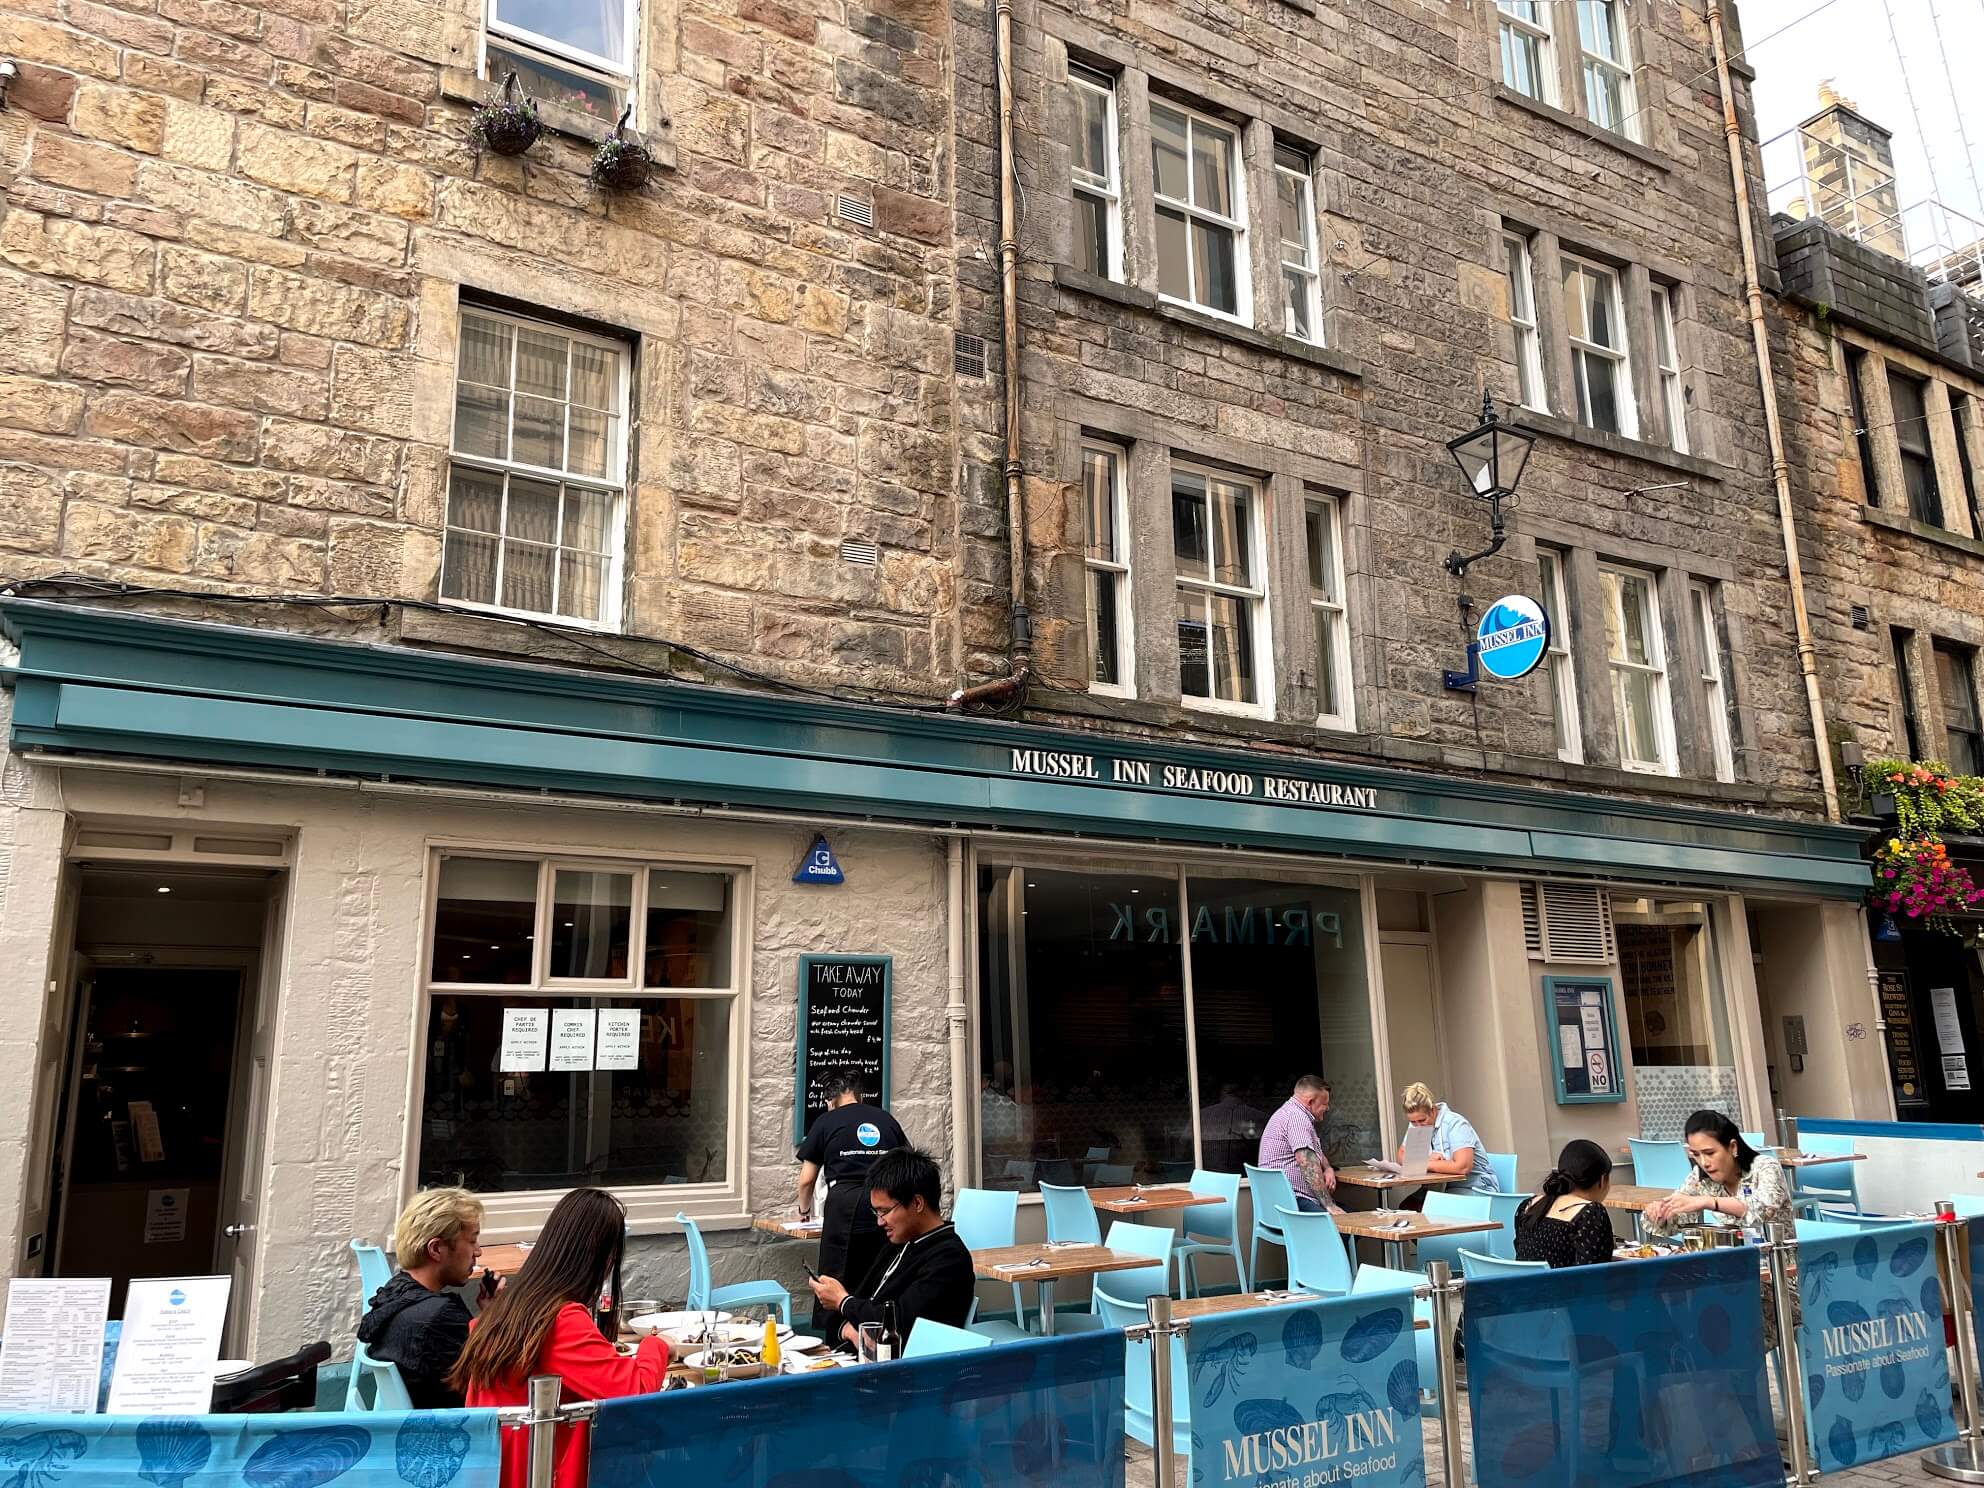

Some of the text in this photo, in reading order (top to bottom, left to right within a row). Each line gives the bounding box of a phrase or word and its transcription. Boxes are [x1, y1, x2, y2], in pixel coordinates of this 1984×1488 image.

[1480, 622, 1545, 651] MUSSEL INN
[1011, 748, 1378, 809] MUSSEL INN SEAFOOD RESTAURANT
[808, 865, 837, 875] Chubb
[812, 964, 881, 984] TAKE AWAY
[831, 987, 863, 998] TODAY
[811, 1004, 869, 1017] Seafood Chowder
[841, 1047, 852, 1055] day
[1592, 1075, 1607, 1086] NO
[1822, 1310, 1929, 1359] MUSSEL INN
[1825, 1344, 1929, 1377] Passionate about Seafood
[1222, 1406, 1396, 1481] MUSSEL INN
[1303, 1464, 1340, 1488] about
[1343, 1452, 1396, 1479] Seafood
